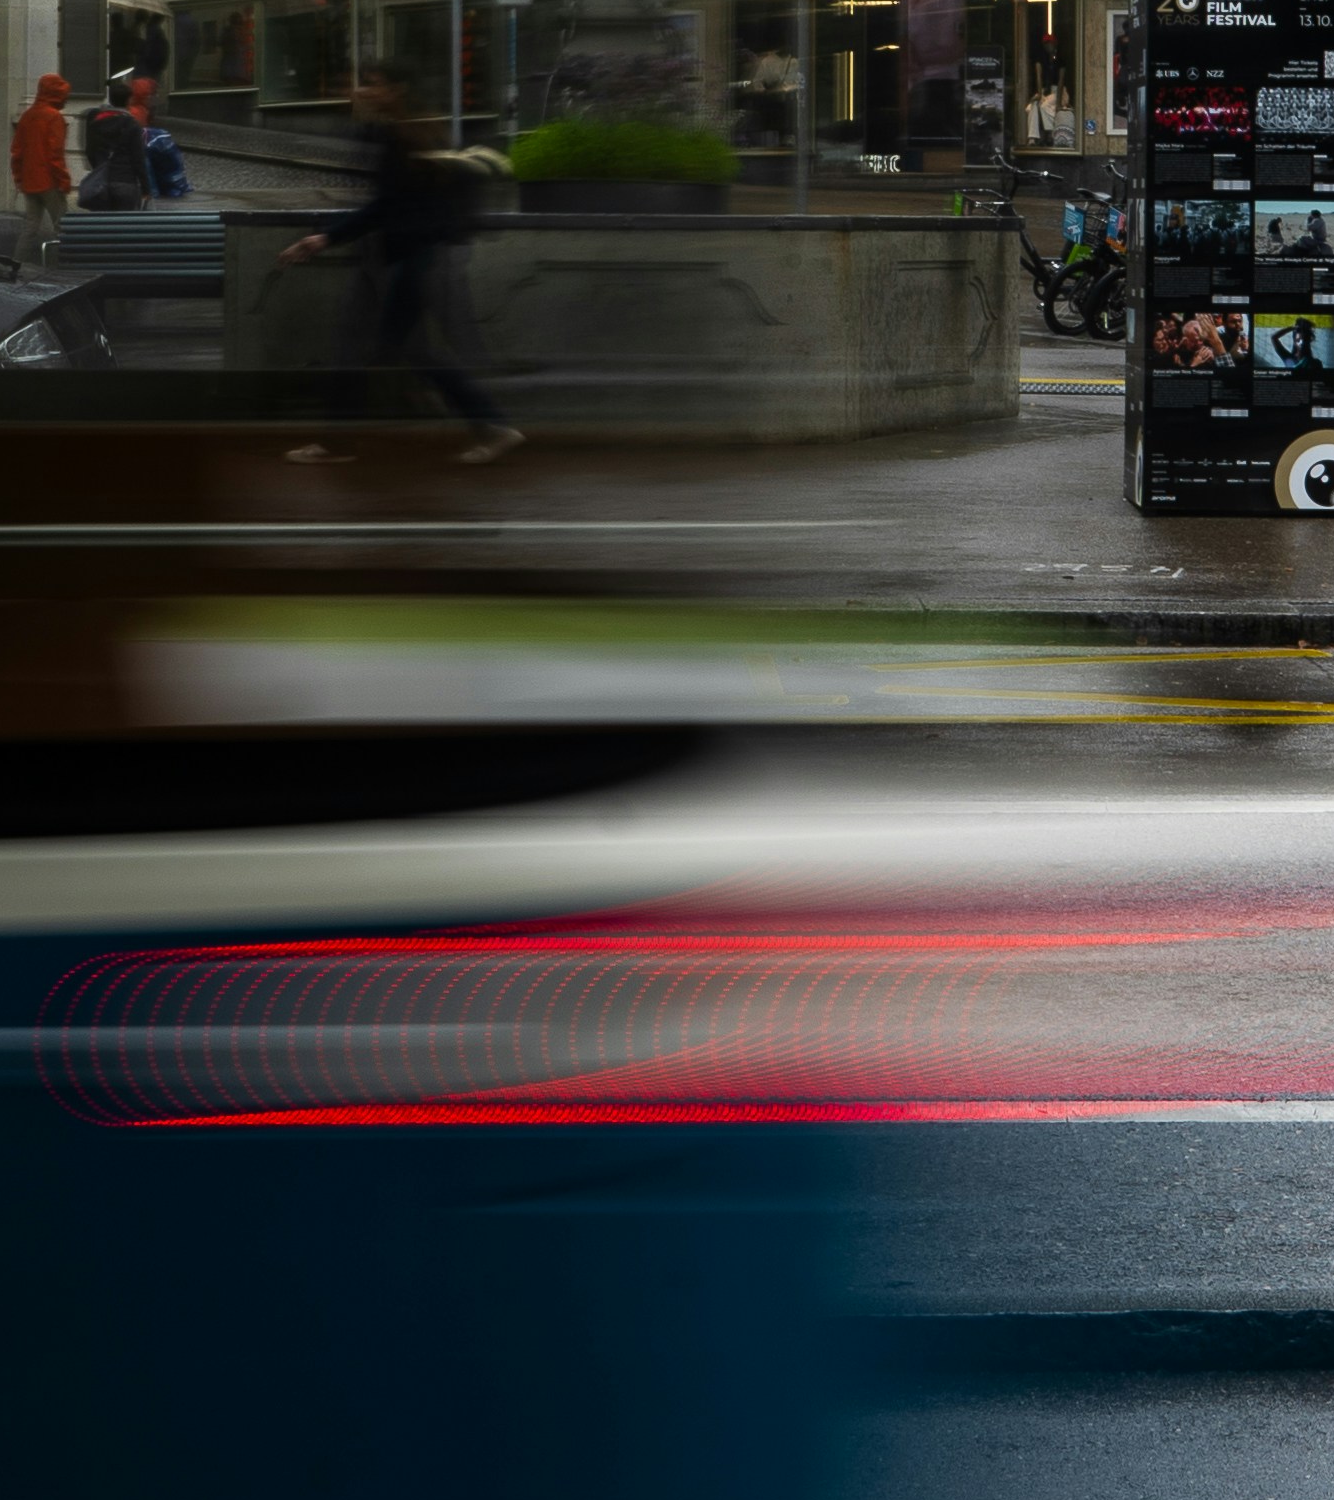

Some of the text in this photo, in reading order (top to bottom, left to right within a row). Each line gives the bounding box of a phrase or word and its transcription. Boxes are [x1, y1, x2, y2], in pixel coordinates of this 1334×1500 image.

[1207, 2, 1242, 13] FILM
[1157, 14, 1200, 26] YEARS
[1207, 15, 1276, 26] FESTIVAL
[1164, 69, 1180, 78] UBS
[1206, 70, 1225, 78] NZZ
